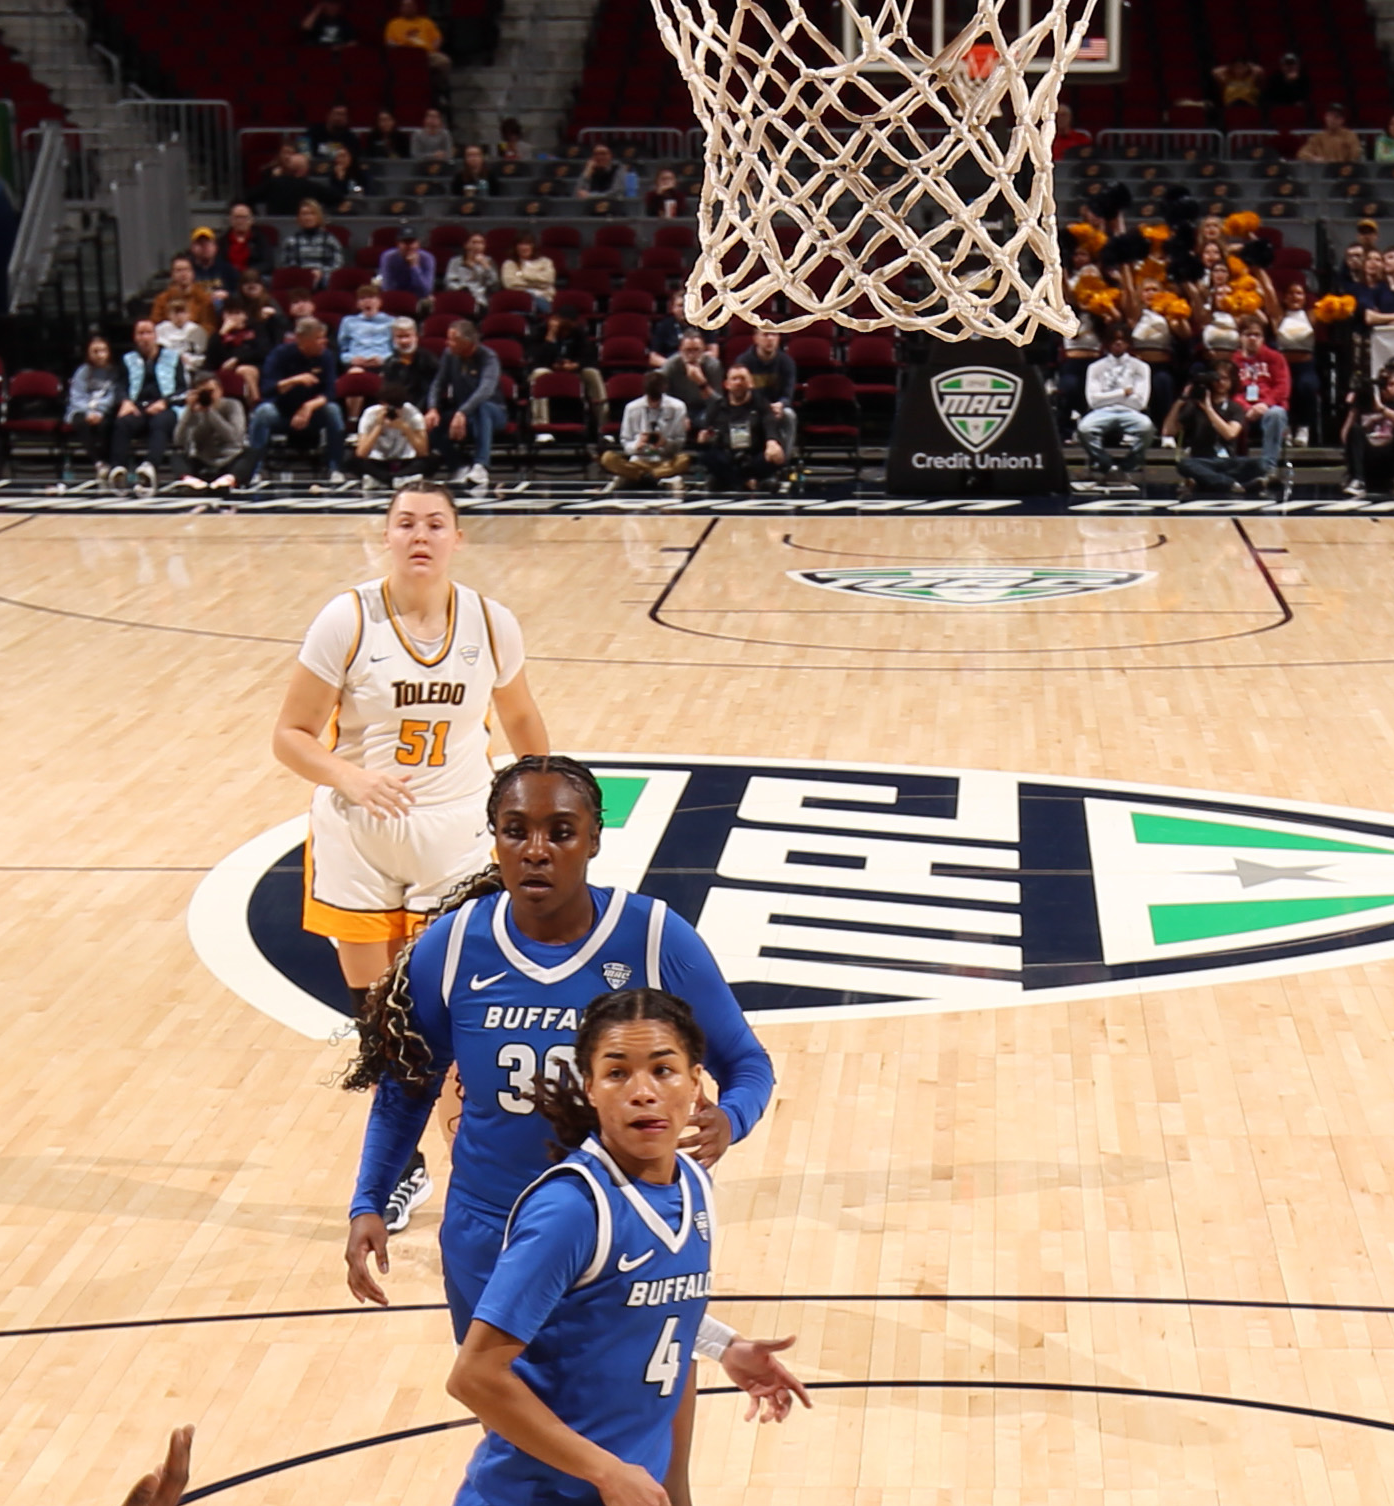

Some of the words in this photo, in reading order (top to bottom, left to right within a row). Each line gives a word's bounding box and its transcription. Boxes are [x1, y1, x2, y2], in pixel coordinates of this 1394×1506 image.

[940, 394, 1012, 415] MAC
[911, 452, 972, 470] Credit
[391, 679, 466, 709] TOLEDO
[394, 718, 451, 767] 51
[693, 774, 1025, 1000] MAC
[483, 1005, 586, 1031] BUFFA
[643, 1316, 681, 1398] 4
